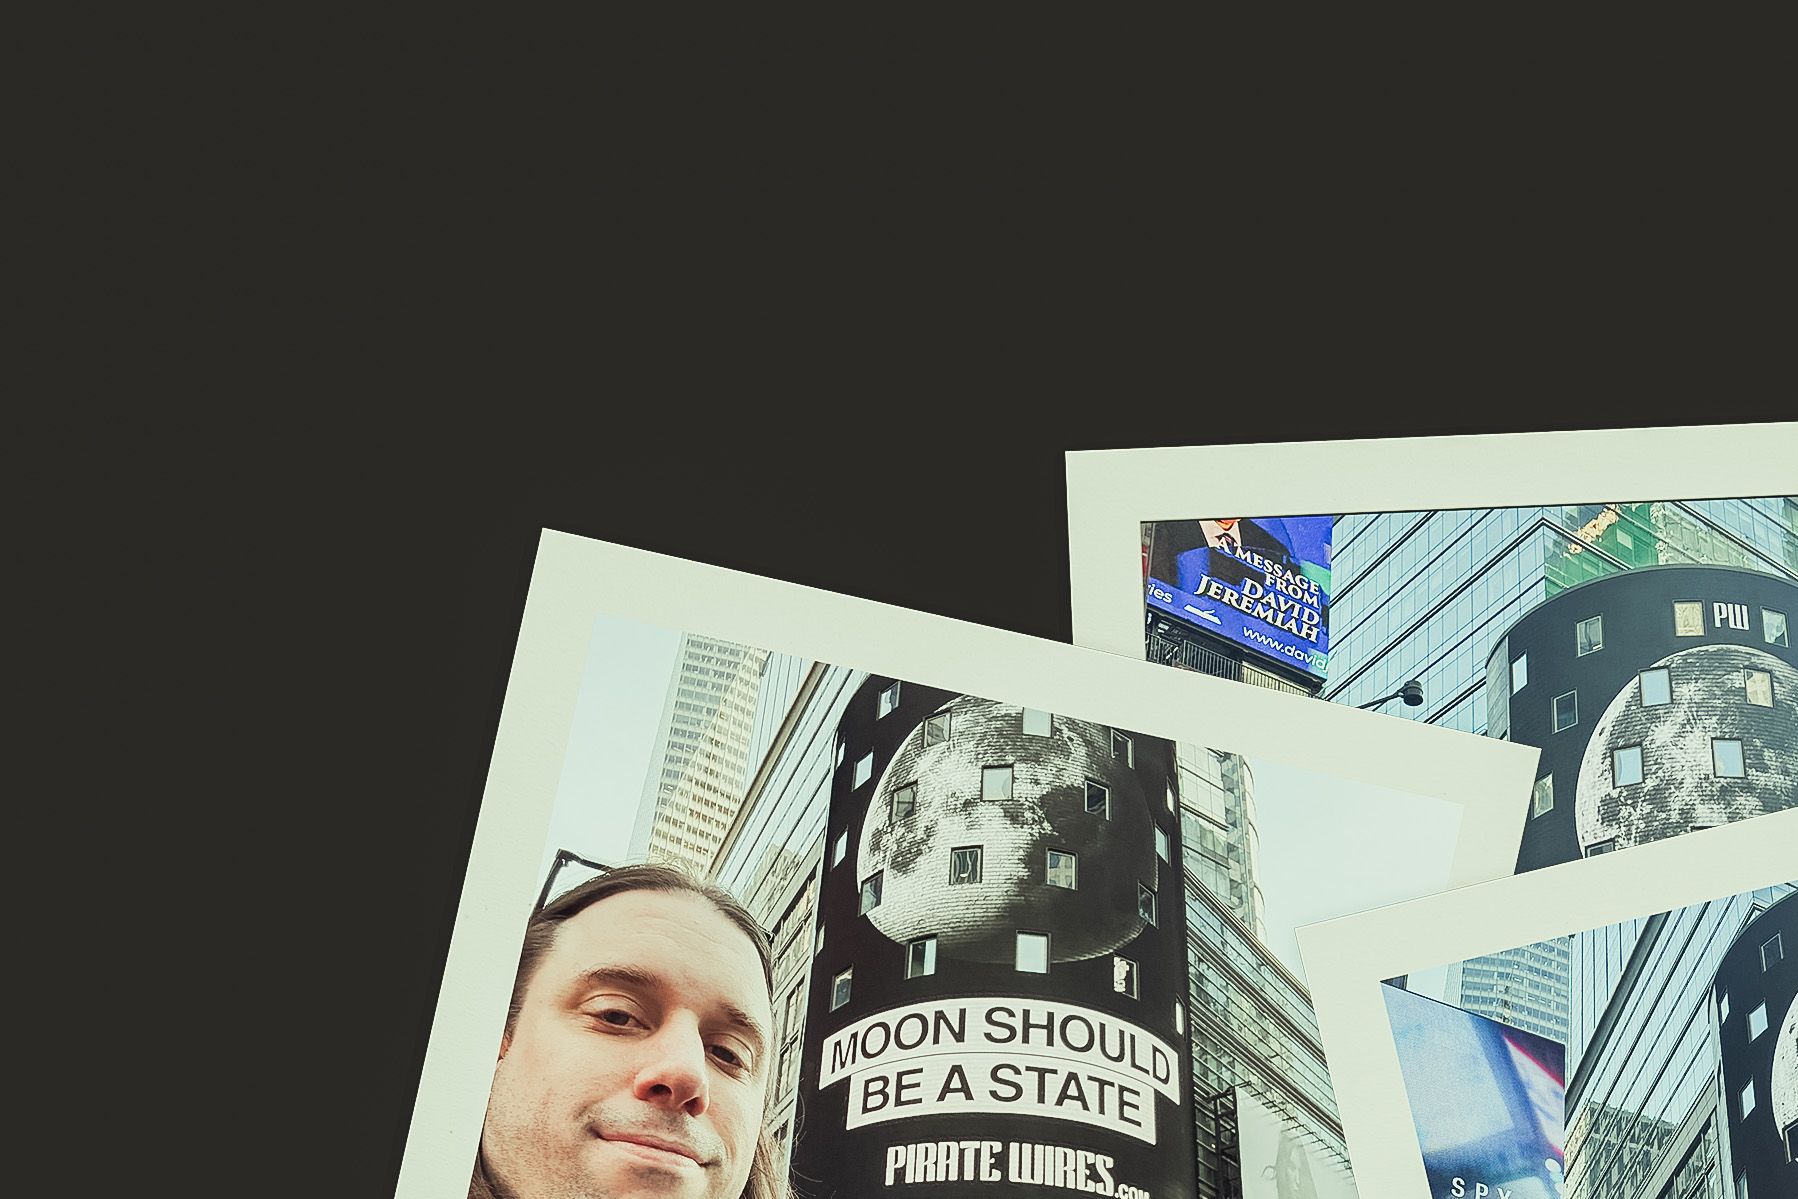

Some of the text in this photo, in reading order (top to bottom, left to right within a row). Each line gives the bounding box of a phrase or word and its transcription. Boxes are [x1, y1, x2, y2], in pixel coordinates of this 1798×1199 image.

[1217, 537, 1320, 594] A MESSAGE
[1264, 573, 1320, 609] FROM
[1194, 573, 1320, 643] JEREMIAH
[1241, 577, 1320, 625] DAVID
[830, 1005, 1171, 1087] MOON SHOULD
[861, 1063, 1143, 1128] BE A STATE
[885, 1140, 1002, 1187] PIRATE
